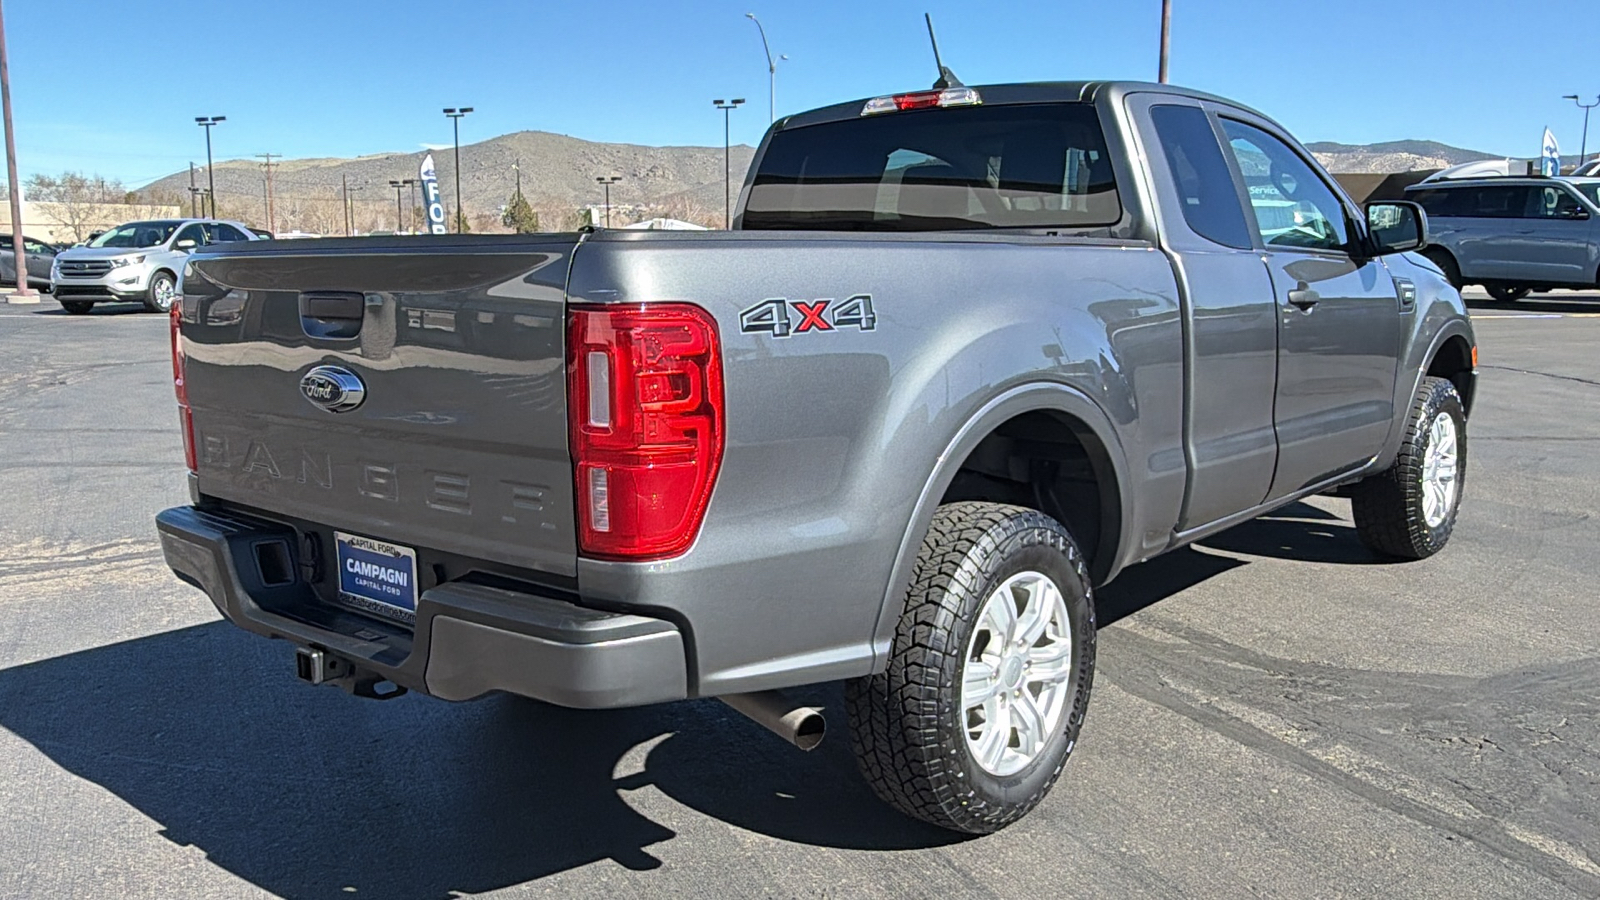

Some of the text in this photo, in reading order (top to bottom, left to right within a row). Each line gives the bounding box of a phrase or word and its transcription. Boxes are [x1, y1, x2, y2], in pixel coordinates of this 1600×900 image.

[306, 377, 332, 399] Ford
[352, 537, 396, 554] CAPITAL FORD
[346, 558, 408, 586] CAMPAGNI
[355, 577, 401, 596] CAPITAL FORD
